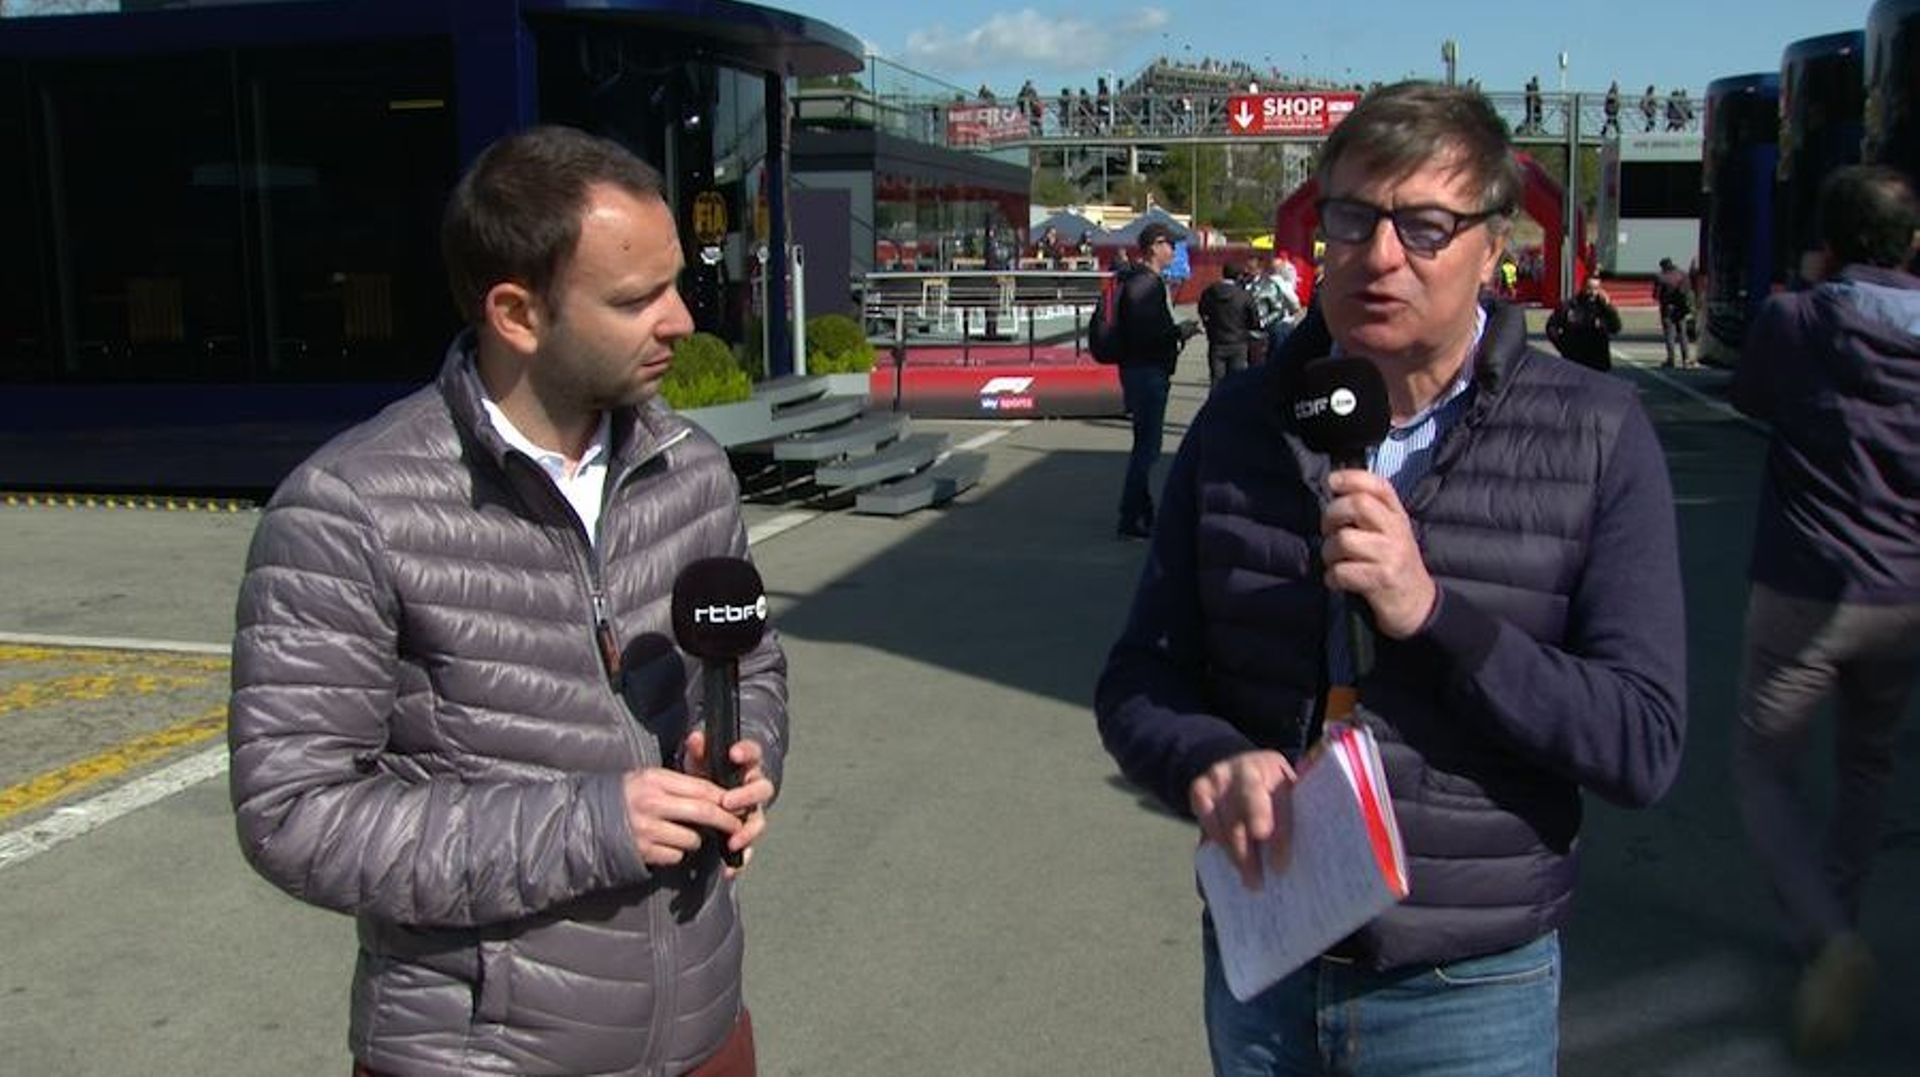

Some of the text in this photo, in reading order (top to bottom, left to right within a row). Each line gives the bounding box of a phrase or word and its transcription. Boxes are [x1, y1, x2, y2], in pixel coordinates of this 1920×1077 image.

[1262, 97, 1324, 116] SHOP
[981, 397, 1033, 410] sky sports
